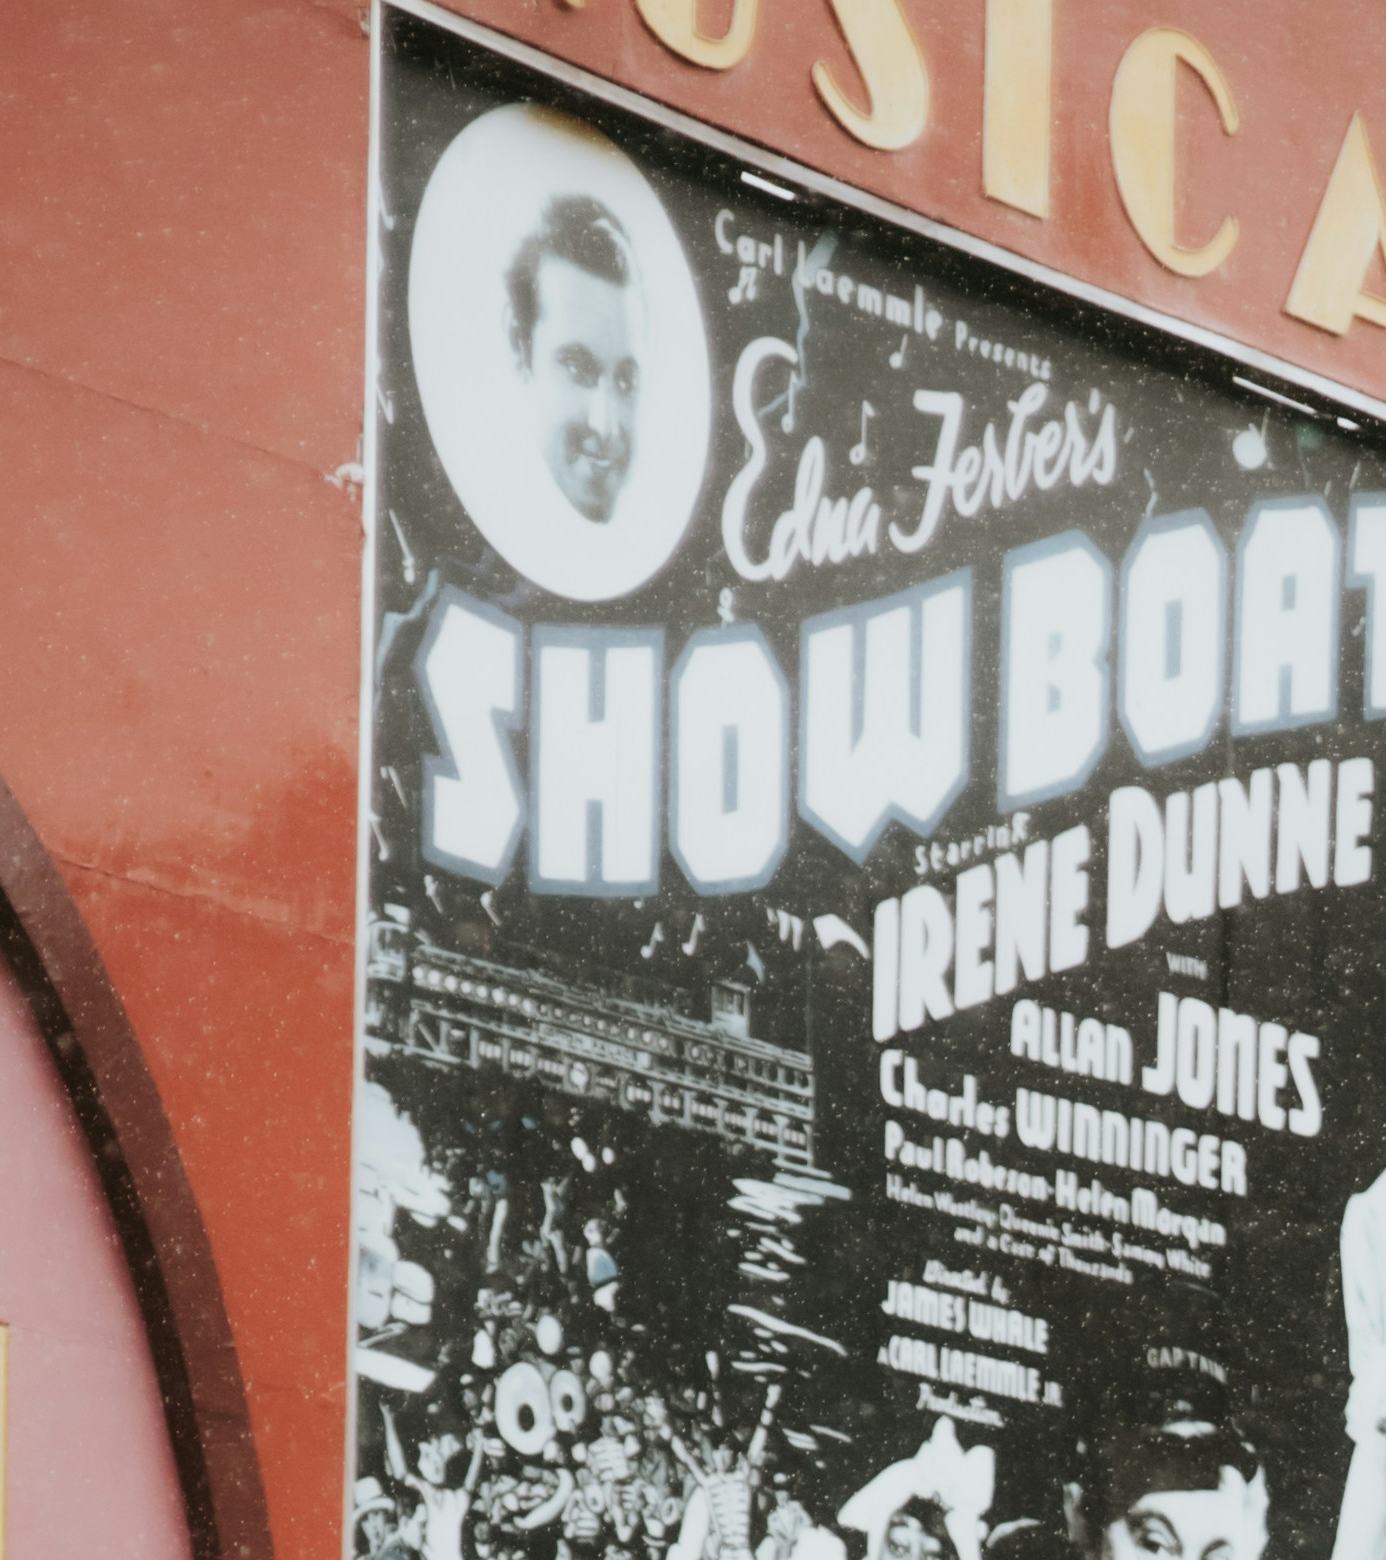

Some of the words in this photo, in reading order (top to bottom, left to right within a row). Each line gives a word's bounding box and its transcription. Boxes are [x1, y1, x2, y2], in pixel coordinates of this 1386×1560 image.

[714, 208, 784, 276] Carl
[797, 240, 944, 341] Laemmle
[954, 320, 1053, 381] Presents
[721, 336, 881, 583] Edna
[888, 382, 1117, 555] Ferber's
[419, 568, 973, 897] SHOW
[871, 824, 1091, 1043] IRENE
[1106, 757, 1375, 949] DUNNE
[879, 1049, 1010, 1139] Charles
[1015, 1087, 1248, 1197] WINNINGER
[1010, 999, 1134, 1085] ALLAN
[1141, 991, 1323, 1137] JONES
[884, 1119, 944, 1175] Paul
[1055, 1168, 1129, 1224] Helen
[1131, 1186, 1226, 1250] Morgan
[880, 1279, 967, 1334] JAMES
[967, 1299, 1049, 1354] WHALE
[888, 1334, 940, 1381] CARL
